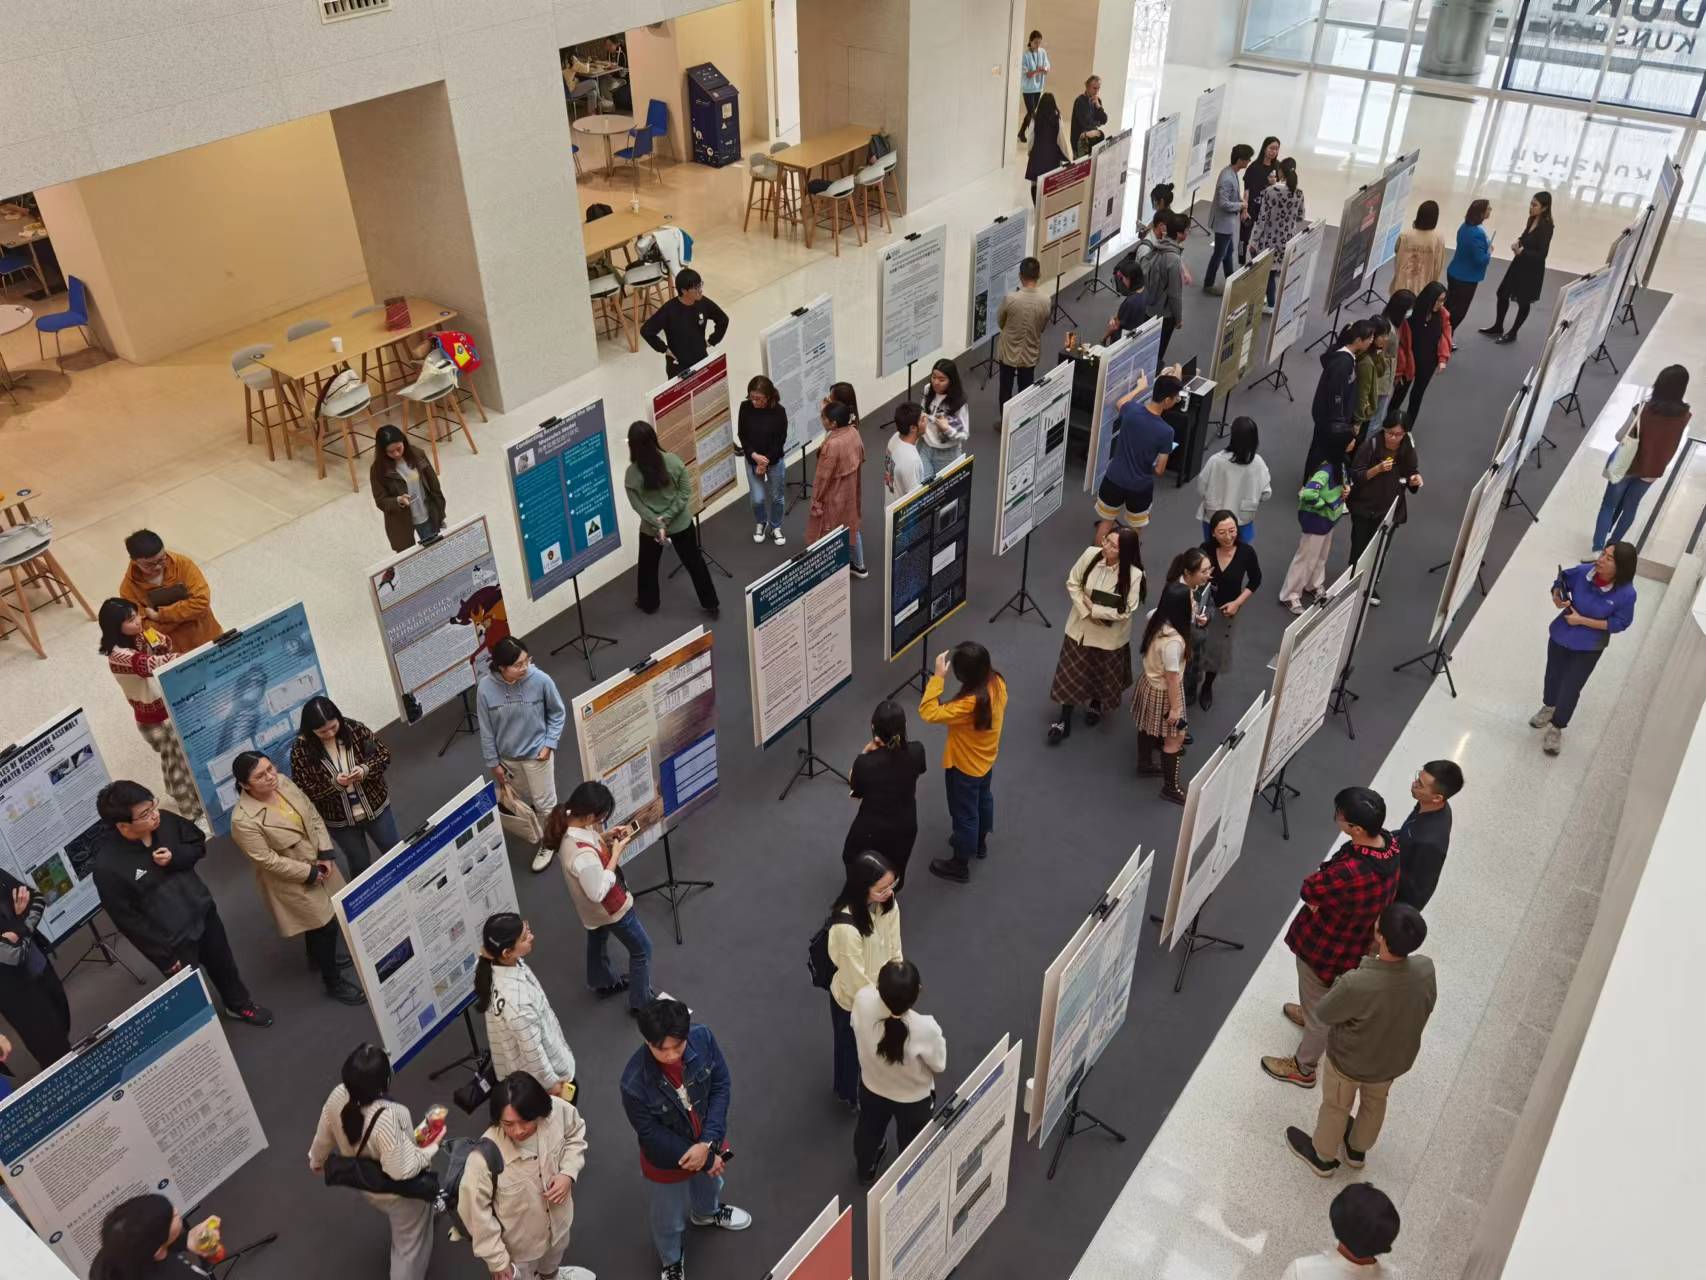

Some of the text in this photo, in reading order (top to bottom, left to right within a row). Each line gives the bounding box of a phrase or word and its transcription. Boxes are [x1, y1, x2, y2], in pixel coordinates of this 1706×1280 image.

[16, 735, 52, 765] MICROBIOME
[50, 717, 79, 741] ASSEMBLY
[20, 743, 56, 772] ECOSYSTEMS
